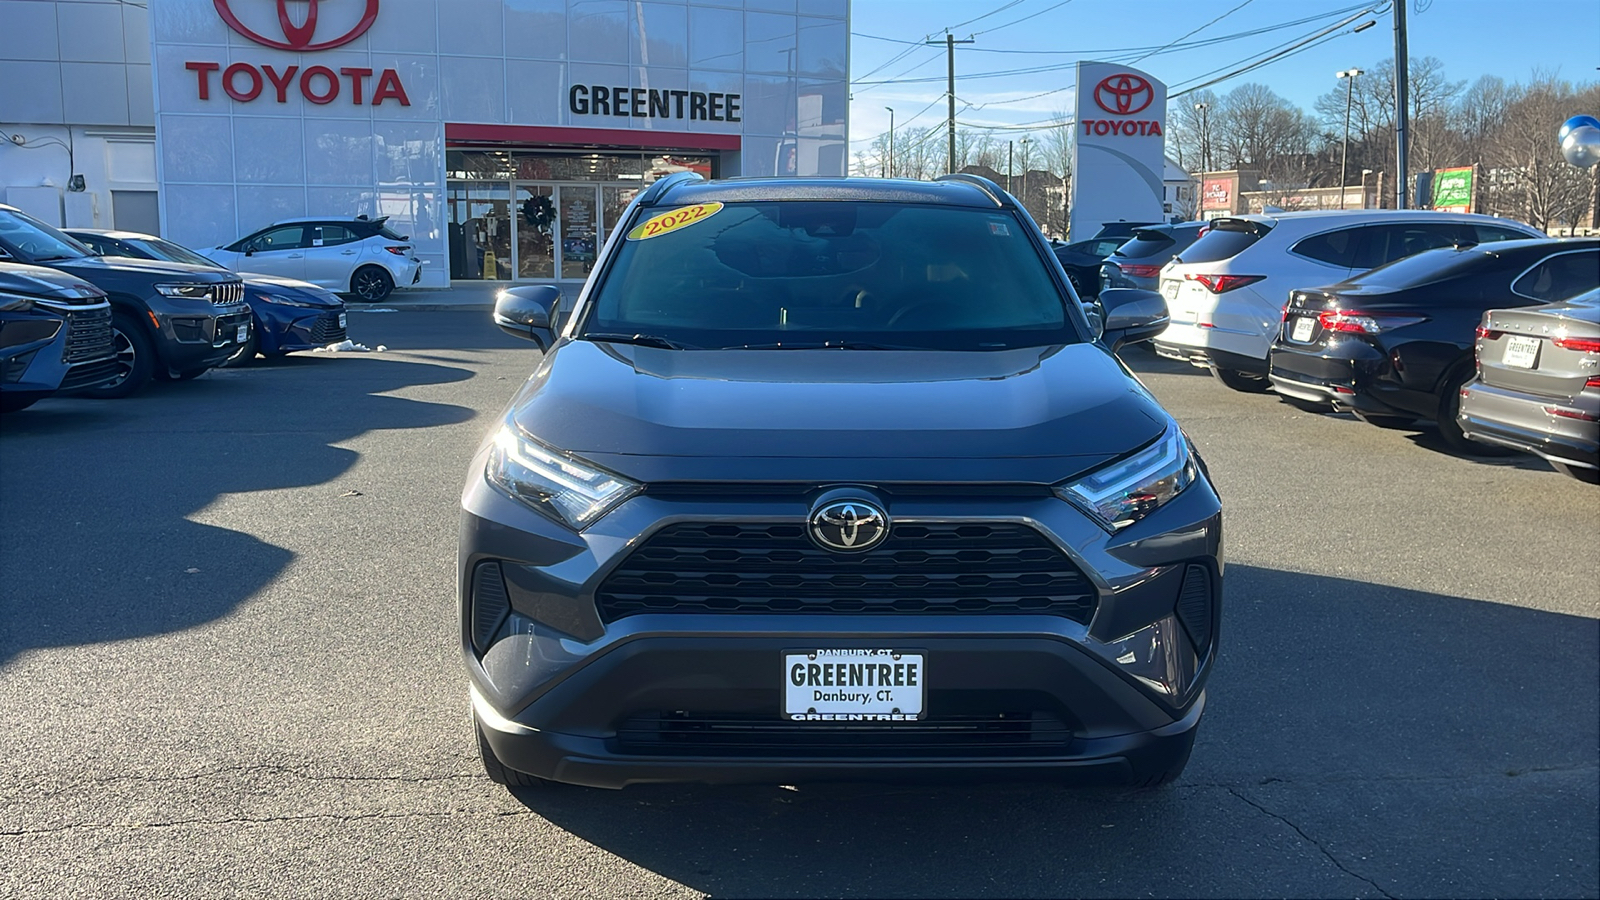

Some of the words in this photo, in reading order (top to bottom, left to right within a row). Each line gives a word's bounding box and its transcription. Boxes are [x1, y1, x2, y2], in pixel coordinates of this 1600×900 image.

[185, 61, 411, 107] TOYOTA
[569, 84, 741, 123] GREENTREE
[1081, 119, 1163, 137] TOYOTA
[645, 206, 708, 236] 2022
[790, 663, 918, 687] GREENTREE
[813, 689, 873, 705] Danbury,
[876, 690, 894, 702] CT.
[790, 713, 919, 721] GREENTREE
